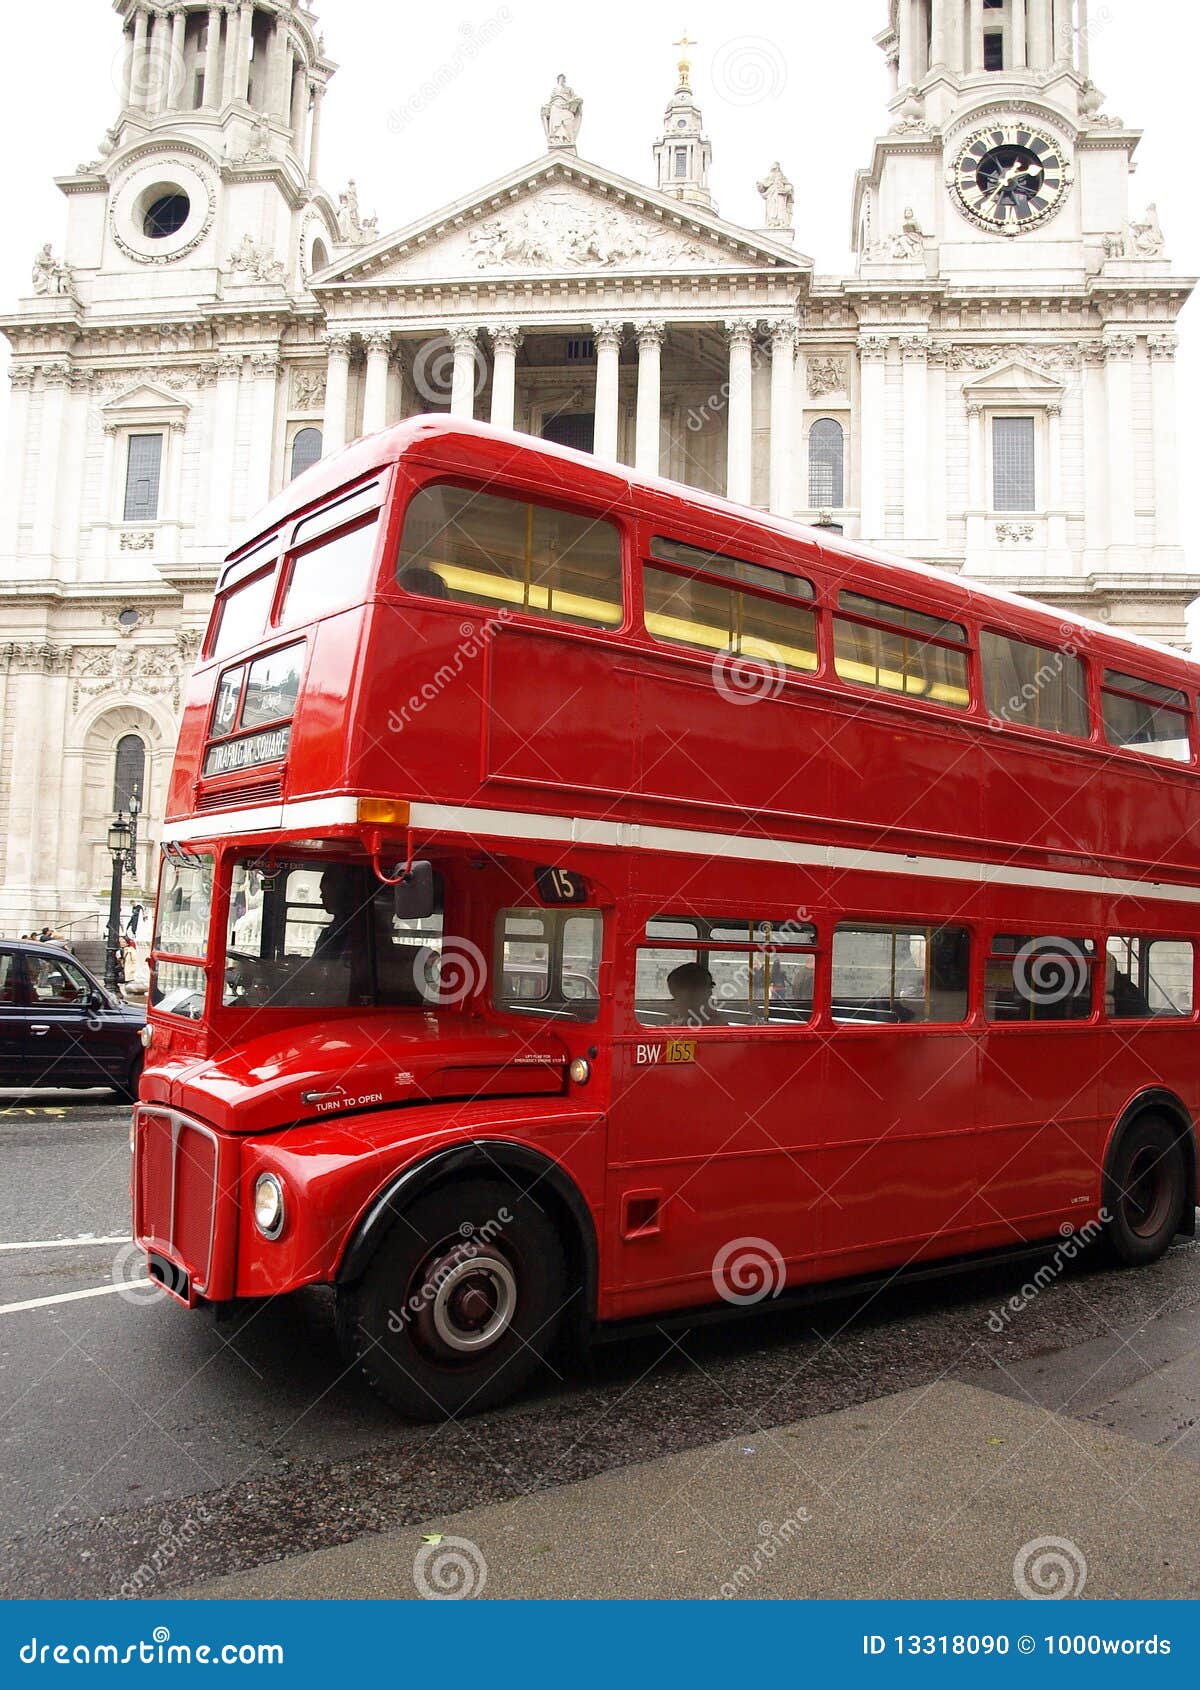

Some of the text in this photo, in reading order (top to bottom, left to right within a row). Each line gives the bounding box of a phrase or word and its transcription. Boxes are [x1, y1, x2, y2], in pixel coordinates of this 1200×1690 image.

[218, 685, 236, 724] 15
[214, 730, 288, 769] TRAFALGAR SQUARE
[551, 869, 575, 898] 15
[636, 1043, 691, 1064] BW 155
[316, 1093, 383, 1111] TURN TO OPEN
